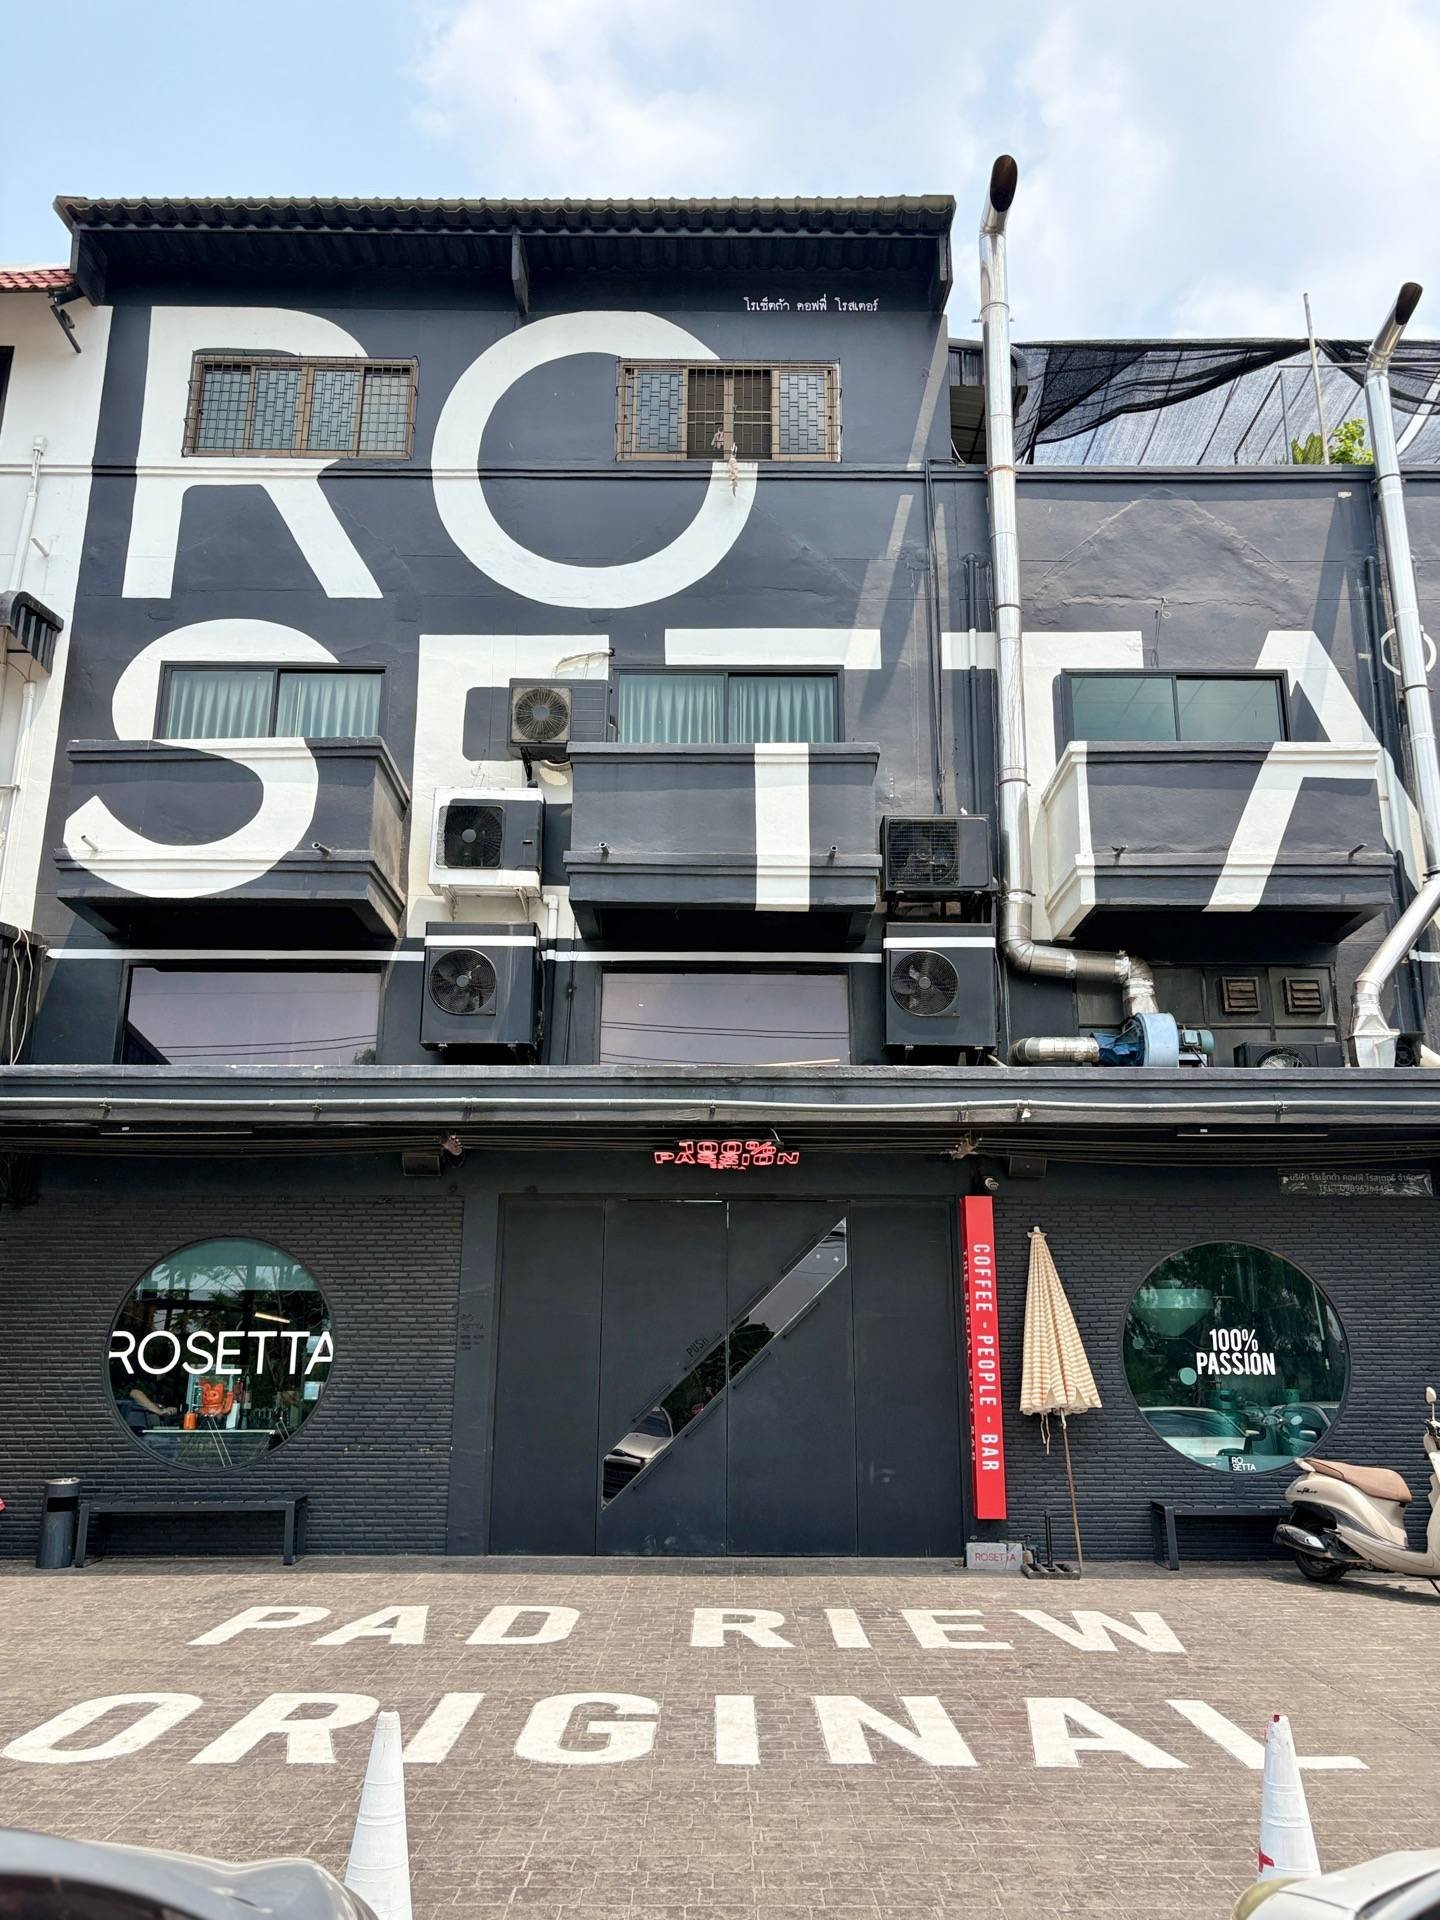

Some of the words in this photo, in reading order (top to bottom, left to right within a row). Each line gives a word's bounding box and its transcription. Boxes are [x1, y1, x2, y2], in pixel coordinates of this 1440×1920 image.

[122, 305, 757, 609] RO
[63, 618, 1440, 940] SETTA
[653, 1152, 800, 1166] PASSION
[678, 1141, 777, 1155] 100%
[973, 1244, 993, 1311] COFFEE
[109, 1330, 334, 1375] ROSETTA
[1209, 1328, 1259, 1352] 100%
[977, 1335, 997, 1406] PEOPLE
[1196, 1352, 1276, 1376] PASSION
[981, 1434, 1000, 1471] BAR
[1231, 1456, 1244, 1465] RO
[1232, 1463, 1257, 1472] SETTA
[188, 1605, 580, 1646] PAD
[690, 1608, 1186, 1654] RIEW
[2, 1692, 1371, 1770] ORIGINAL
